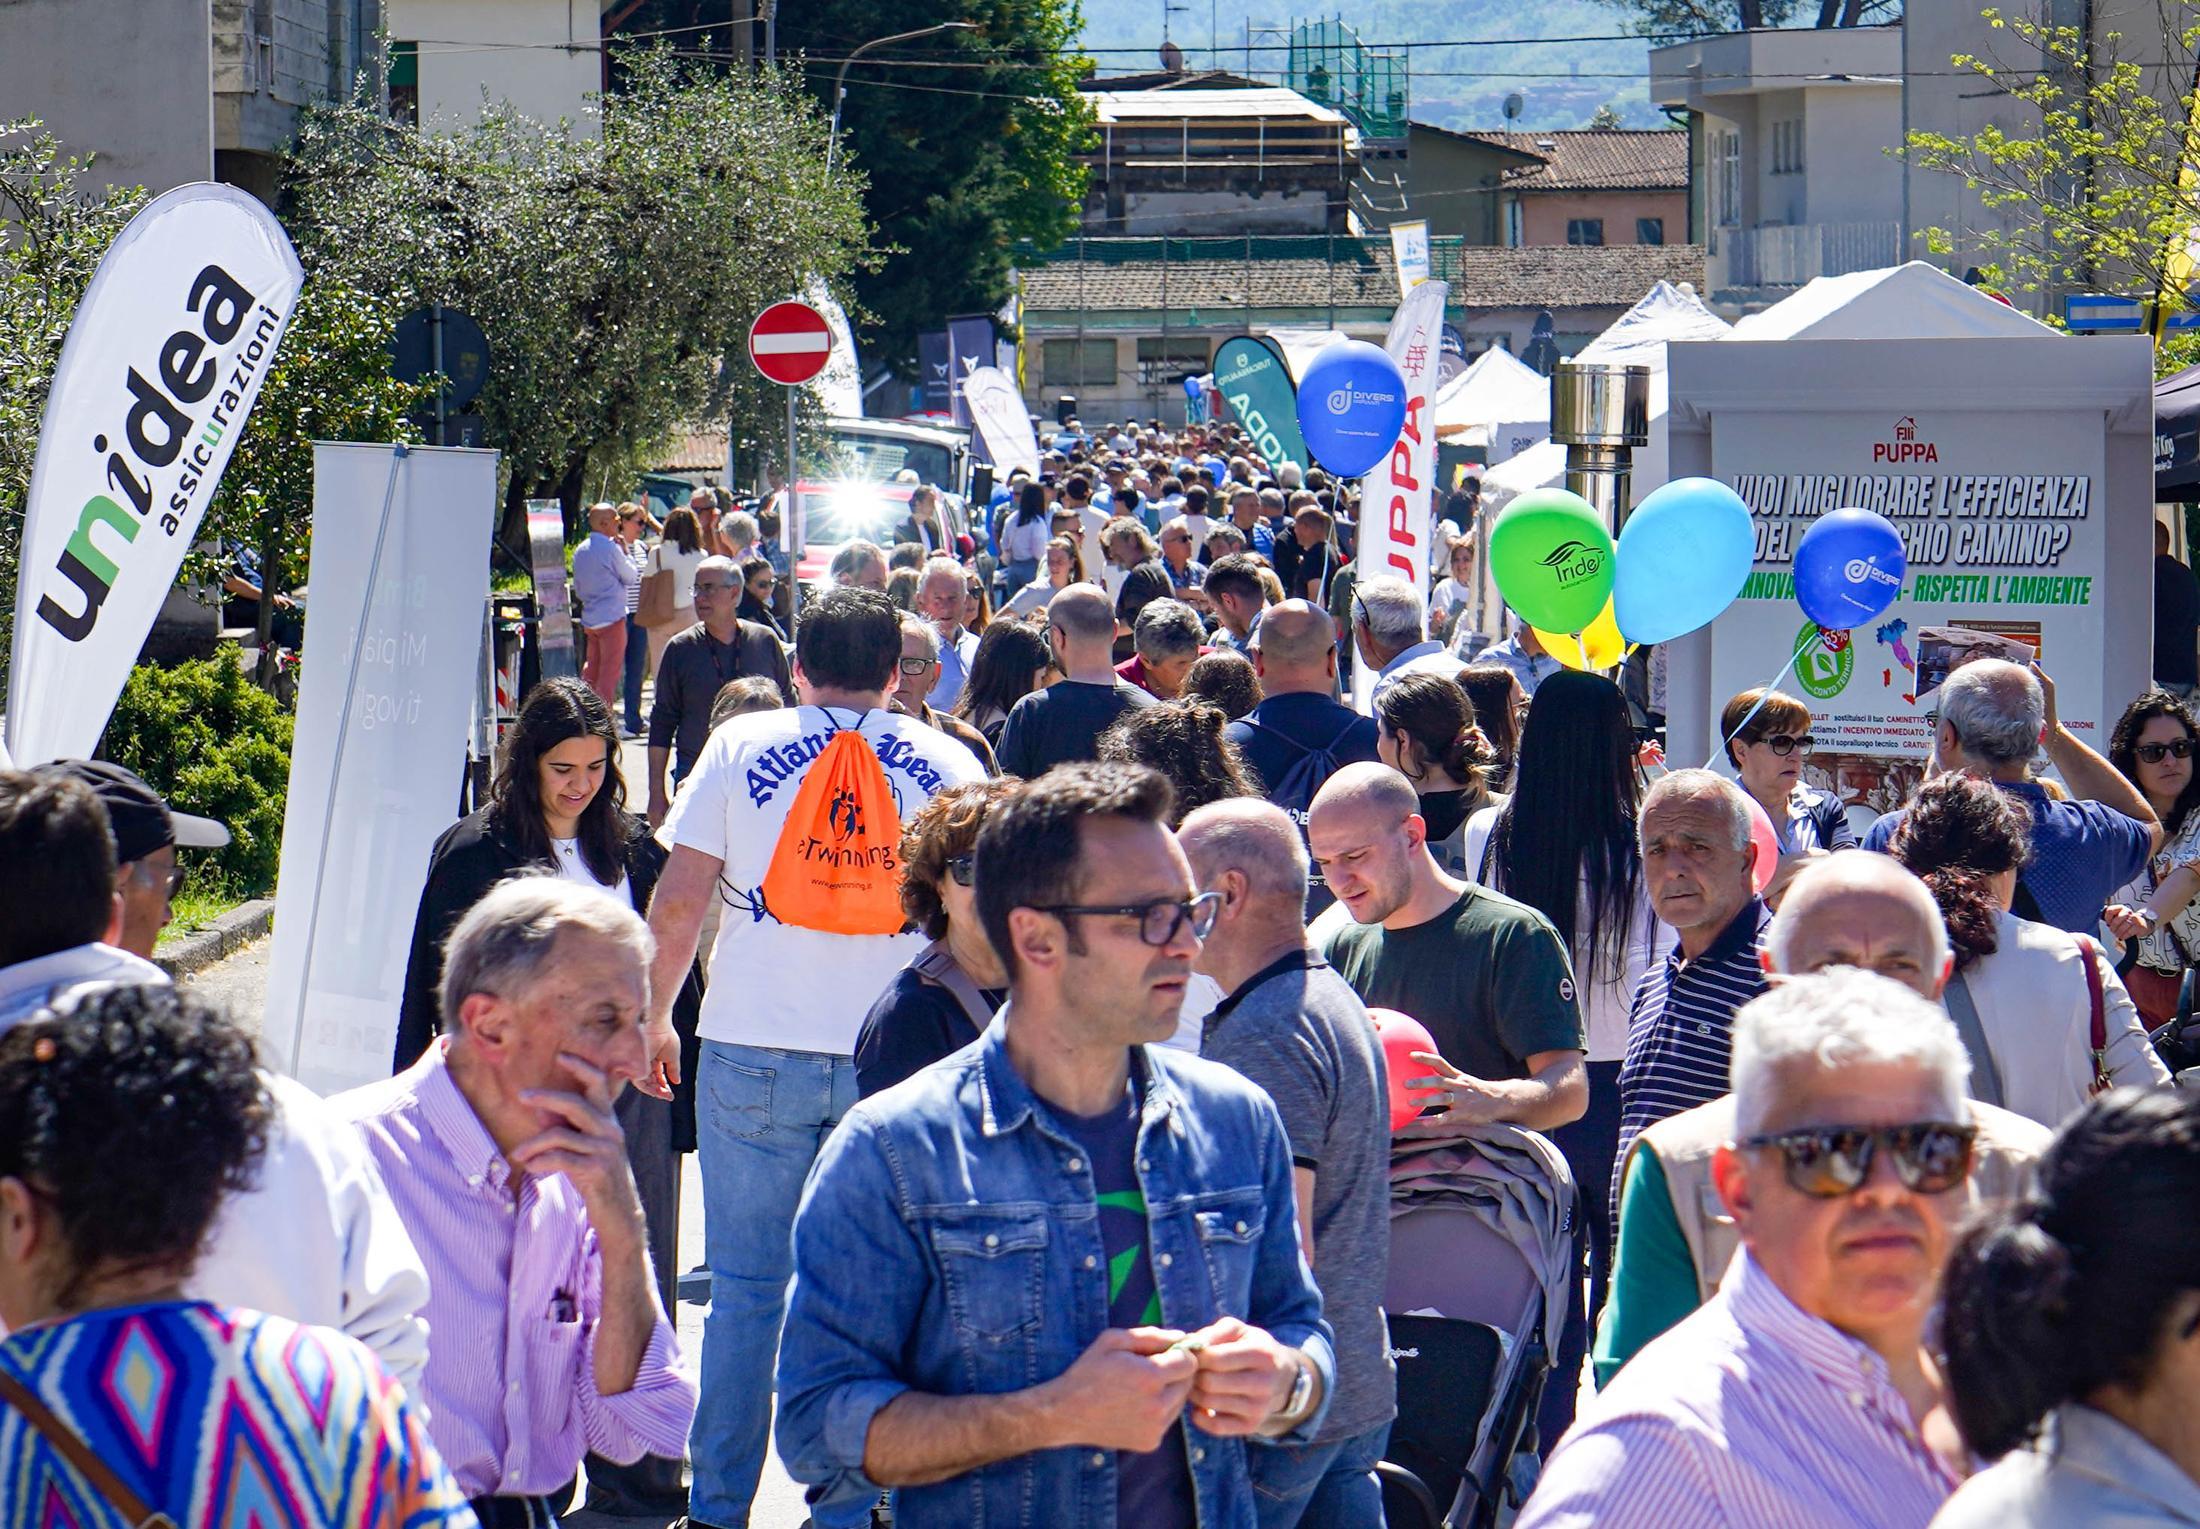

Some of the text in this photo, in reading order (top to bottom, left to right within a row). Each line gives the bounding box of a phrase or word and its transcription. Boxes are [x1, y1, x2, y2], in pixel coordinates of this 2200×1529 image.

[160, 304, 280, 537] assicurazioni
[36, 264, 256, 642] unidea
[1873, 442, 1938, 463] PUPPA
[1387, 395, 1426, 583] UPPA
[1733, 474, 2091, 519] VUOI MIGLIORARE L'EFFICIENZA
[1754, 520, 2071, 567] DEL CHIO CAMINO?
[1913, 574, 1990, 604] RISPETTA
[1812, 647, 1854, 697] CONTO TERMICO
[1809, 725, 1837, 734] uttiamo
[1843, 726, 1882, 735] INCENTIVO
[1883, 728, 1925, 737] IMMEDIATO
[1810, 713, 1829, 722] ELLET
[1834, 713, 1867, 723] sostituisci
[1873, 715, 1884, 723] tuo
[1886, 715, 1926, 724] CAMINETTO
[2062, 721, 2096, 729] OLIZIONE
[876, 732, 944, 796] Lea
[1836, 739, 1874, 748] sopralluogo
[1875, 740, 1899, 748] tecnico
[1902, 741, 1935, 750] GRATUIT
